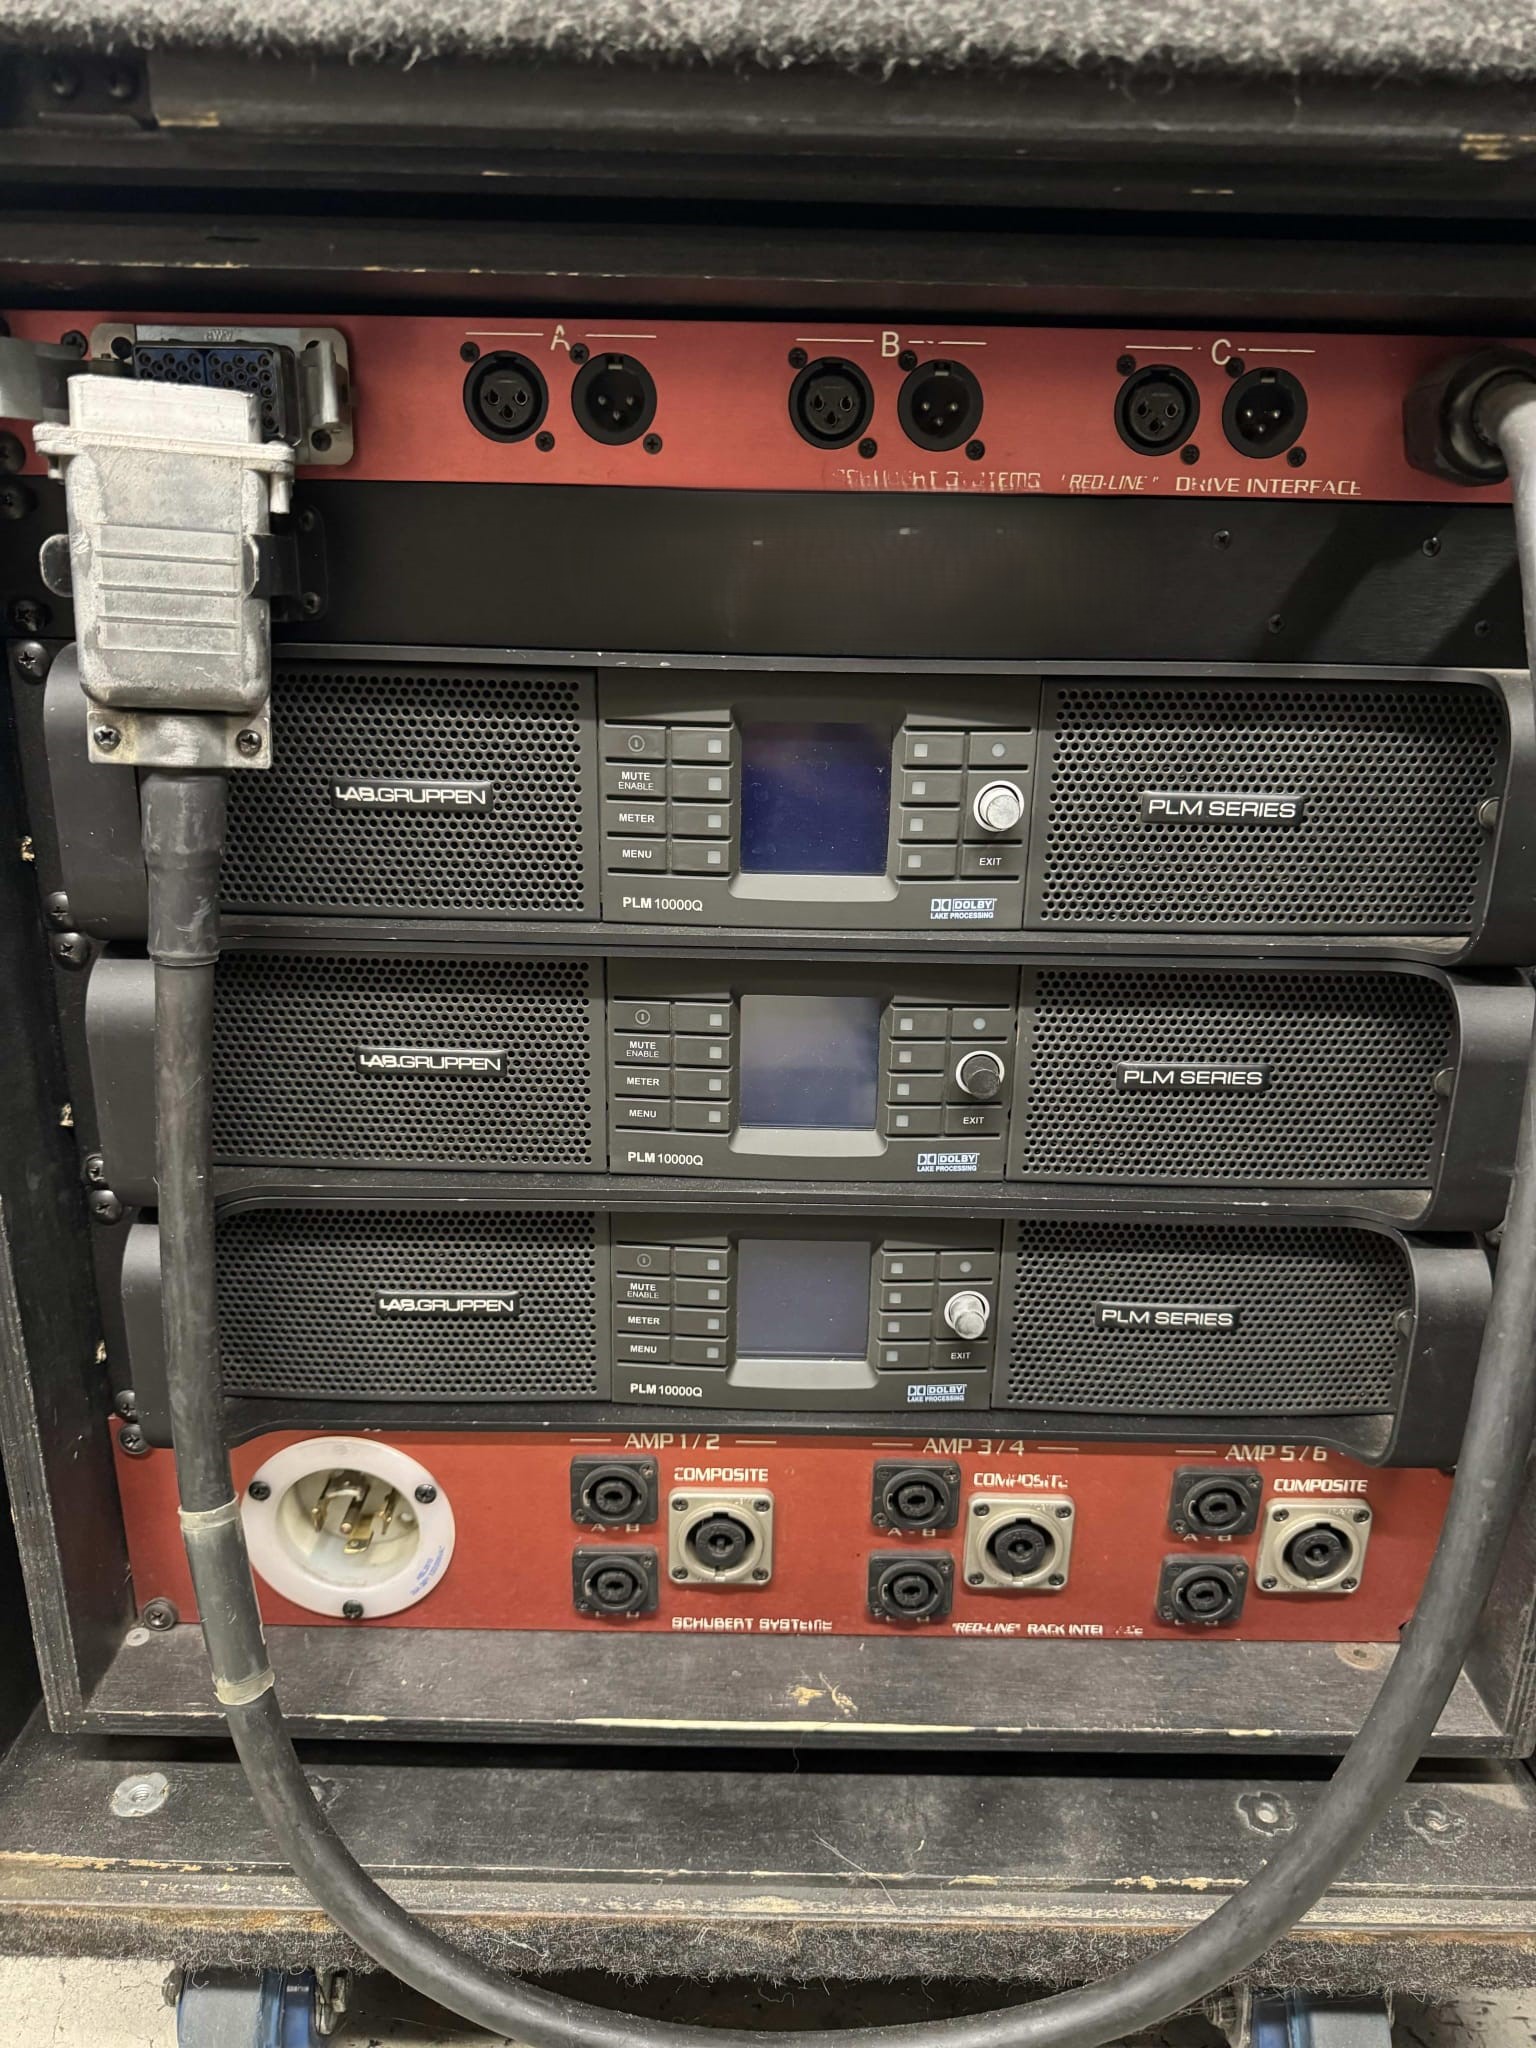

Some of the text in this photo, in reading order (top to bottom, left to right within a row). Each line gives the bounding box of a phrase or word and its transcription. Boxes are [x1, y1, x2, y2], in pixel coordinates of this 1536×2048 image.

[550, 324, 570, 351] A
[882, 331, 900, 358] B
[1211, 338, 1231, 366] C
[1176, 476, 1239, 493] DRIVE
[1247, 477, 1362, 496] INTERFACE
[621, 771, 651, 781] MUTE
[618, 781, 655, 791] ENABLE
[335, 786, 486, 805] LAB.GRUPPEN
[1149, 799, 1296, 818] PLM SERIES
[619, 813, 655, 824] METER
[622, 849, 652, 859] MENU
[979, 857, 1002, 866] EXIT
[622, 896, 703, 912] PLM 10000Q
[954, 900, 993, 909] DOLBY
[930, 911, 994, 920] LAKE PROCESSING
[629, 1041, 657, 1050] MUTE
[626, 1050, 660, 1058] ENABLE
[360, 1054, 501, 1071] LAB.GRUPPEN
[627, 1076, 660, 1086] METER
[1124, 1070, 1263, 1085] PLM SERIES
[629, 1109, 657, 1118] MENU
[963, 1116, 984, 1125] EXIT
[628, 1151, 704, 1166] PLM 10000Q
[939, 1154, 976, 1163] DOLBY
[630, 1282, 656, 1291] MUTE
[627, 1290, 660, 1299] ENABLE
[379, 1298, 514, 1312] LAB.GRUPPEN
[628, 1316, 661, 1325] METER
[1102, 1309, 1234, 1326] PLM SERIES
[630, 1344, 657, 1354] MENU
[950, 1352, 972, 1360] EXIT
[630, 1382, 703, 1397] PLM 10000Q
[929, 1385, 963, 1394] DOLBY
[624, 1433, 674, 1450] AMP
[922, 1437, 973, 1455] AMP
[1225, 1444, 1276, 1462] AMP
[674, 1467, 769, 1482] COMPOSITE
[1273, 1478, 1368, 1493] COMPOSITE
[671, 1617, 754, 1630] SCHUBERT
